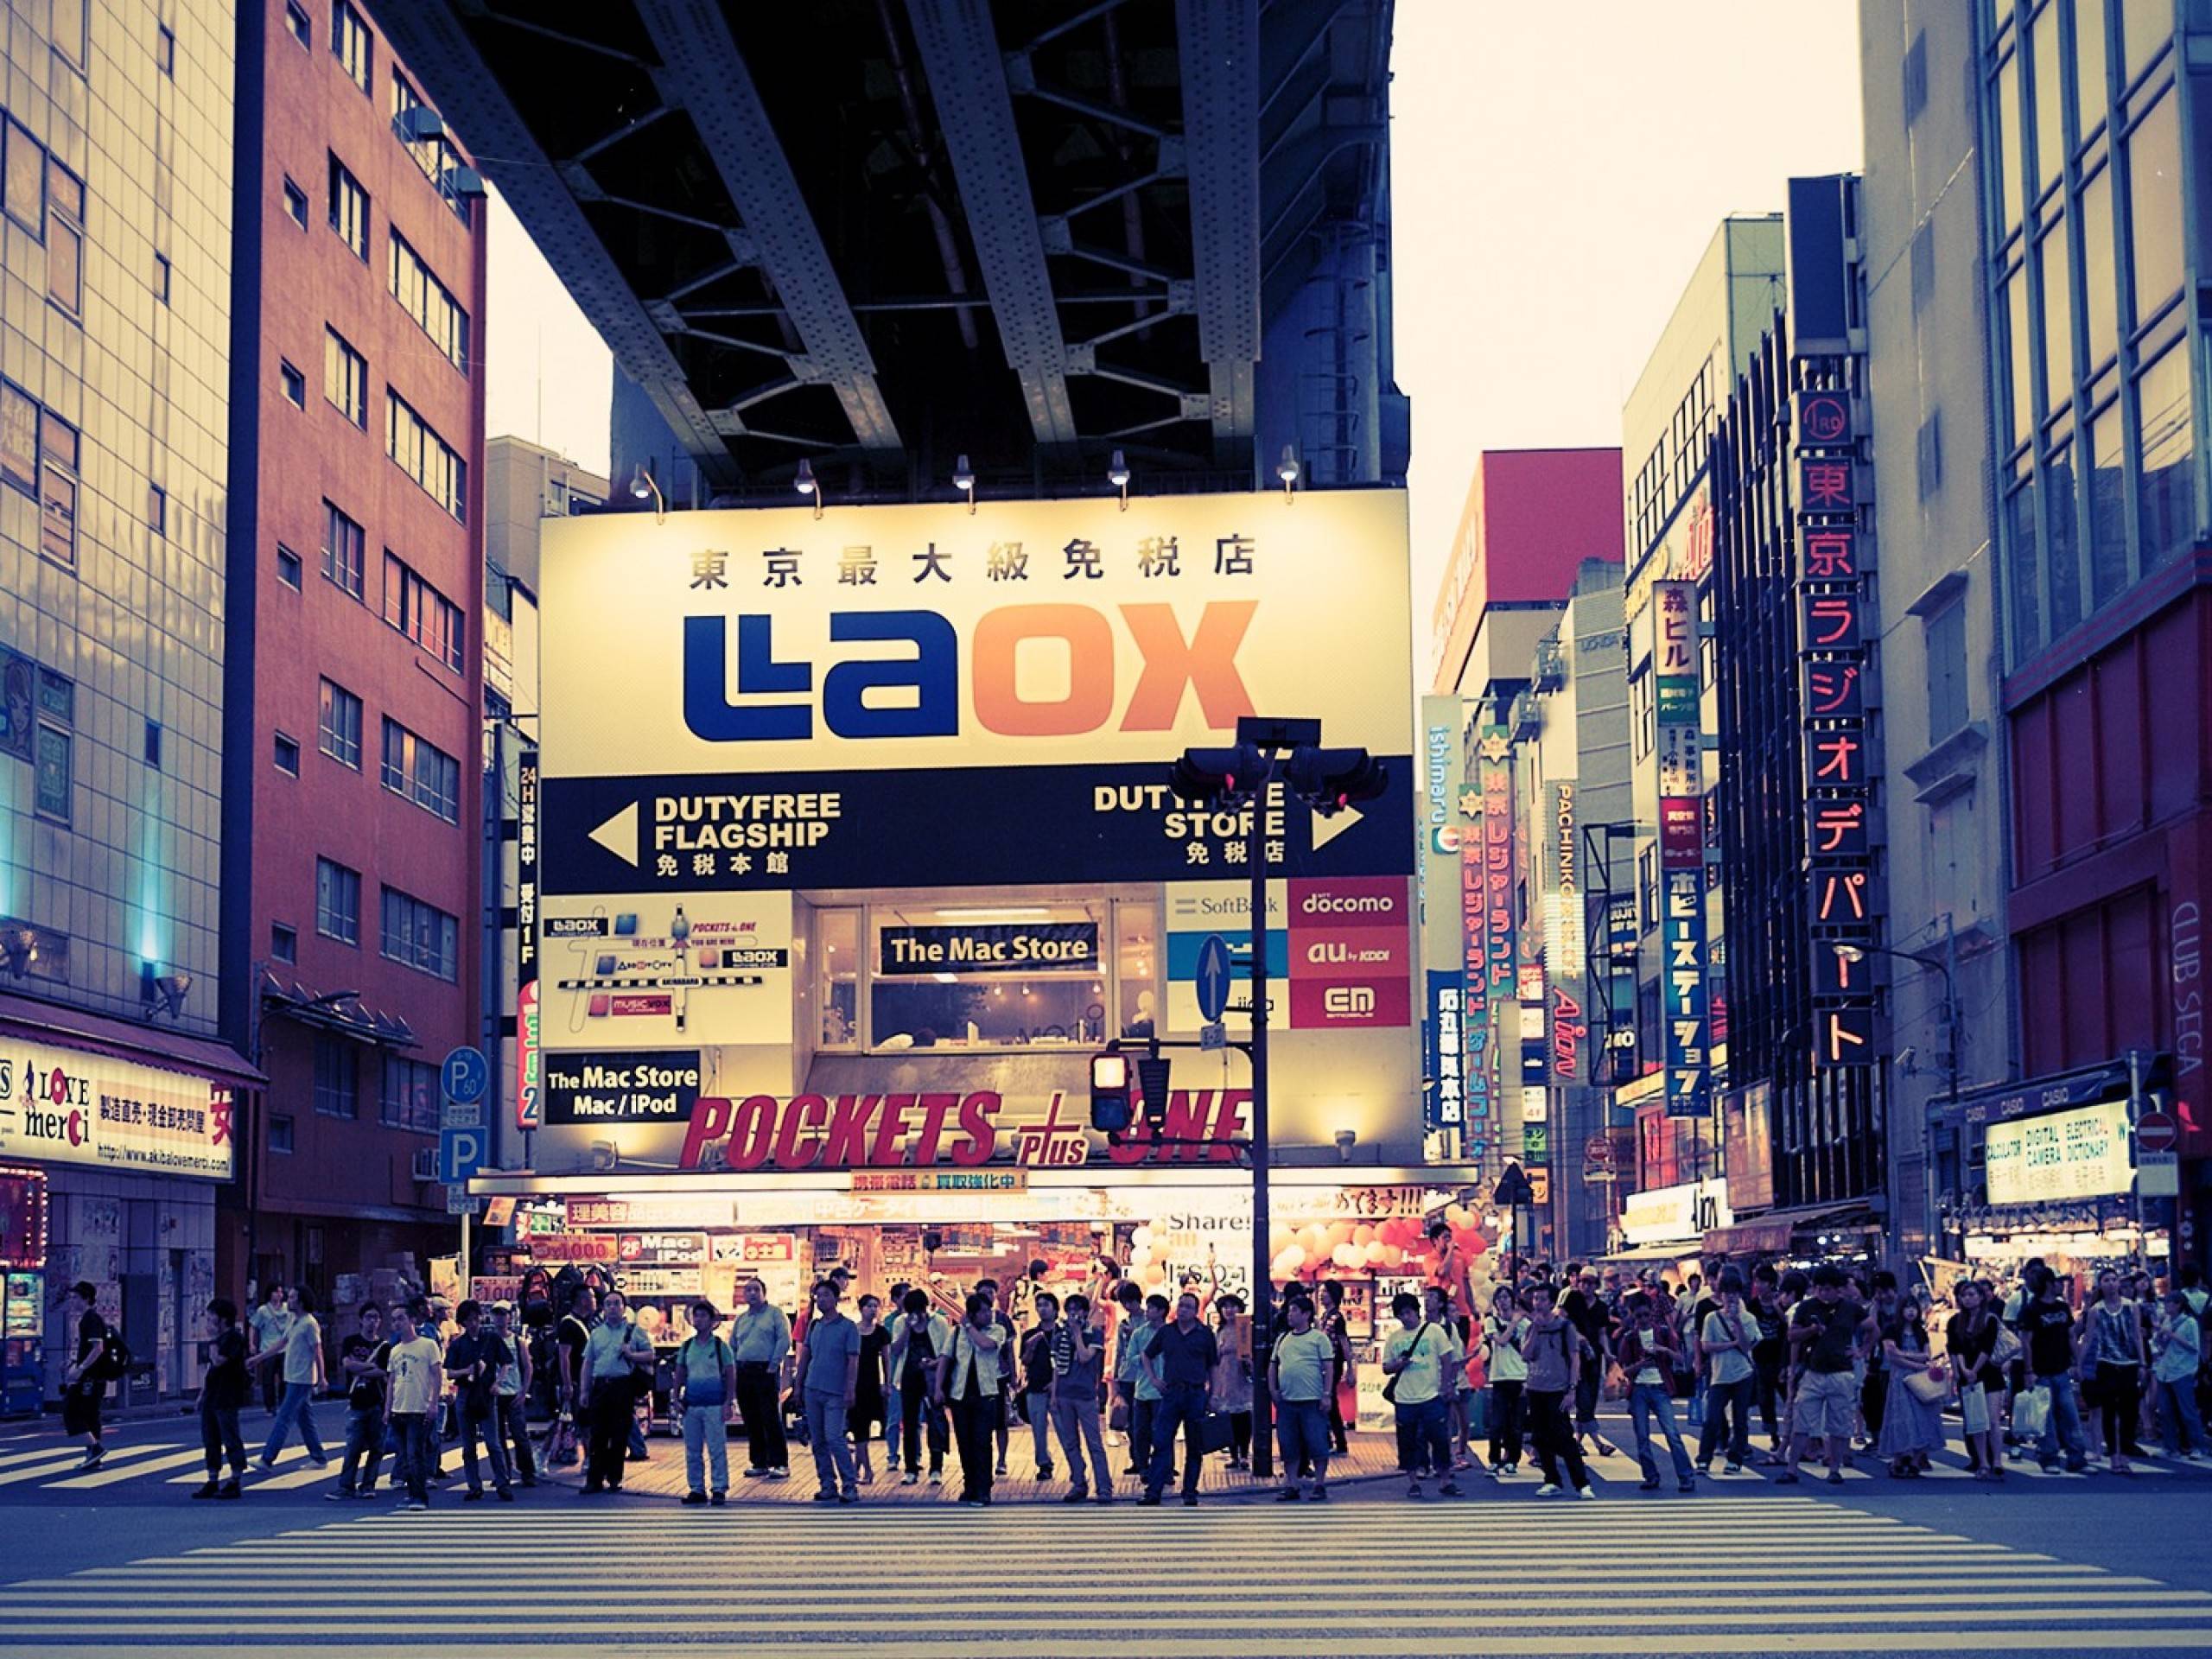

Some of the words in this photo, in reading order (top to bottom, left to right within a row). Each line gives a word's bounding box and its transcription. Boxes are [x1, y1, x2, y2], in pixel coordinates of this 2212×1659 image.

[690, 537, 1253, 591] 東京最大級免税店
[1664, 588, 1690, 668] 森ビル
[1428, 727, 1449, 823] ishimaru
[1805, 464, 1868, 1063] 東京ラジオデパート
[655, 792, 841, 822] DUTYFREE
[1094, 782, 1284, 810] DUTE
[655, 822, 830, 850] FLAGSHIP
[1186, 840, 1285, 864] 免税店
[1558, 785, 1575, 899] PACHINKO
[657, 851, 789, 877] 免税本館
[1484, 772, 1511, 987] 東京レジャーランド
[1201, 897, 1279, 914] SoftBk
[1302, 893, 1394, 912] docomo
[1462, 825, 1484, 1016] 東京レジャーランド
[892, 936, 942, 961] The
[949, 935, 1008, 960] Mac
[1014, 934, 1088, 959] Store
[1307, 944, 1345, 963] au
[2172, 901, 2199, 982] CLUB
[1670, 873, 1701, 1093] ホビーステーション
[1553, 987, 1588, 1078] Aion
[2175, 990, 2202, 1077] SEGA
[39, 1066, 90, 1105] LOVE
[451, 1061, 468, 1095] P
[550, 1073, 579, 1088] The
[582, 1069, 630, 1088] Mac
[634, 1066, 698, 1087] Store
[574, 1097, 615, 1116] Mac
[631, 1094, 677, 1114] iPod
[1966, 1105, 1986, 1123] CASIO
[2000, 1097, 2024, 1116] CASIO
[2042, 1087, 2069, 1107] CASIO
[680, 1092, 1002, 1169] POCKETS
[451, 1134, 478, 1178] P
[1169, 1211, 1251, 1231] Share!
[642, 1236, 692, 1249] Mac
